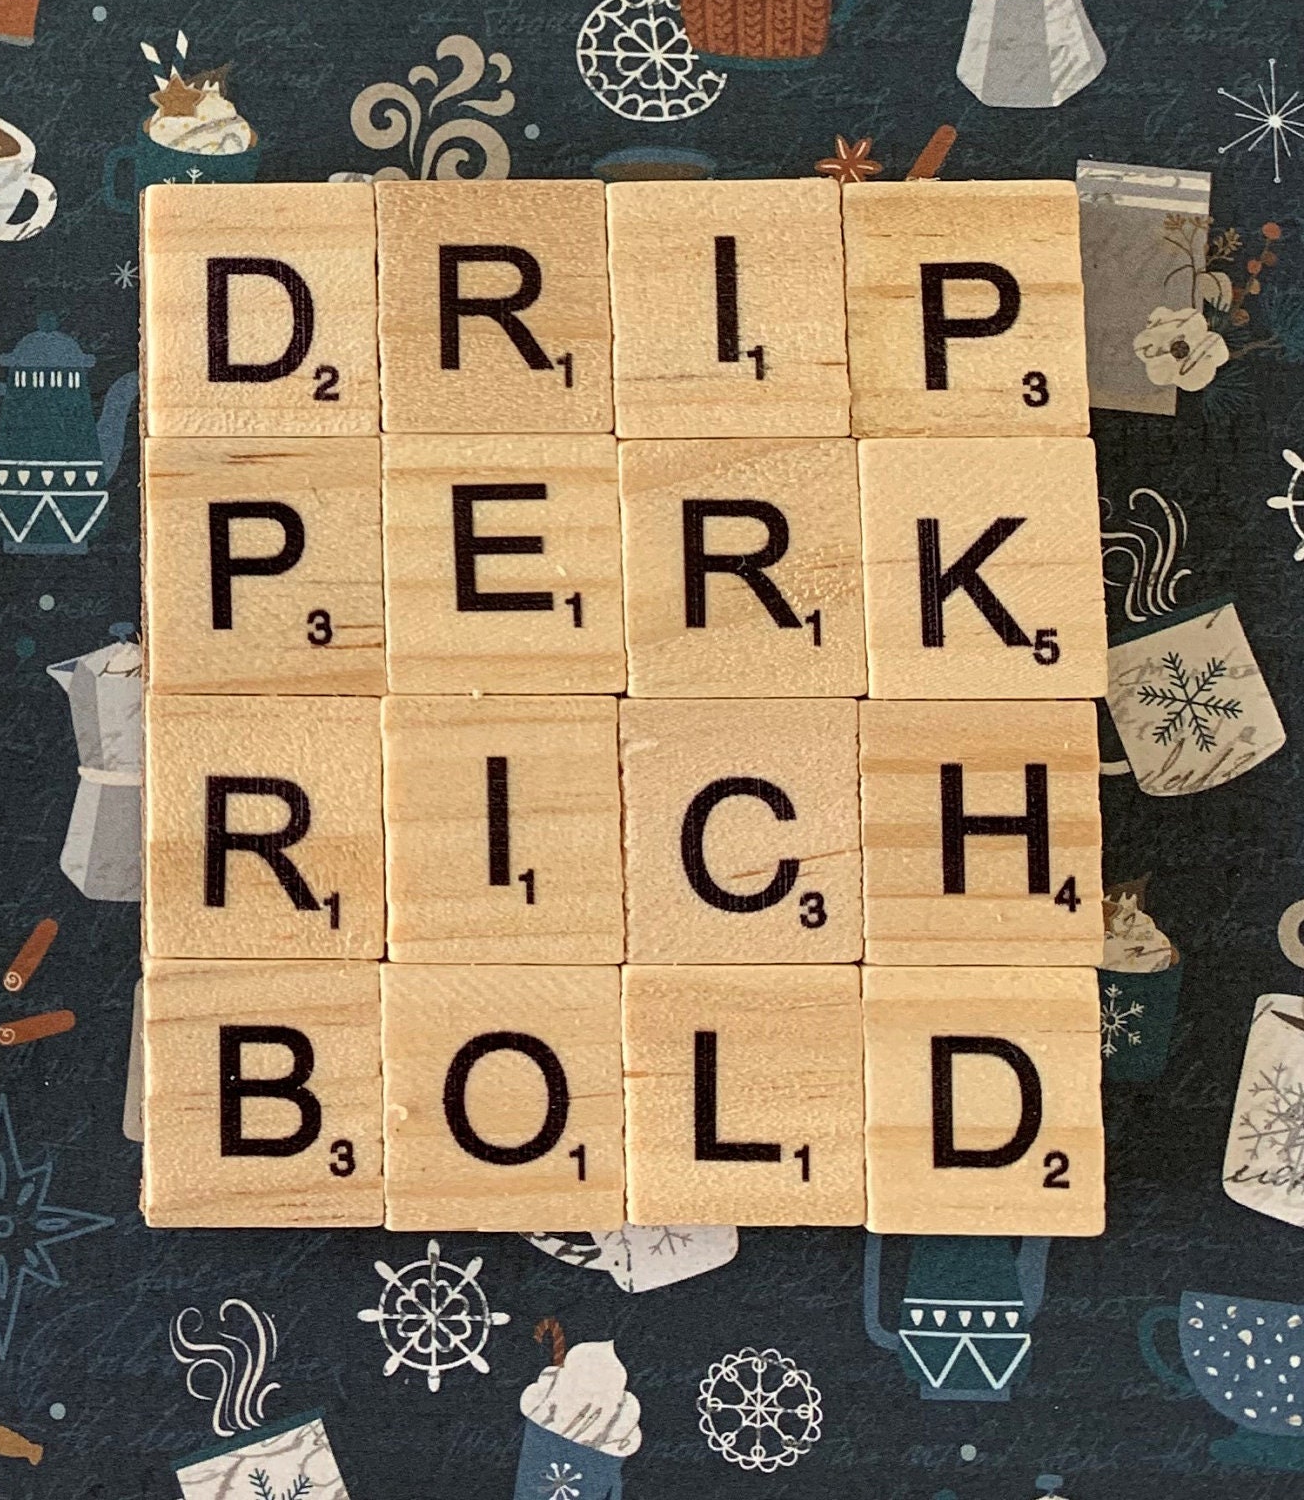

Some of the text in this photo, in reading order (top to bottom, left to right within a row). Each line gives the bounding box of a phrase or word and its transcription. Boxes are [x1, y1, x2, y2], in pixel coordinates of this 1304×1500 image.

[311, 344, 1051, 409] 2 1 1 3
[305, 590, 1062, 667] 3 1 1 5
[321, 867, 1083, 931] 1 1 3 4
[328, 1137, 1071, 1190] 3 1 1 2
